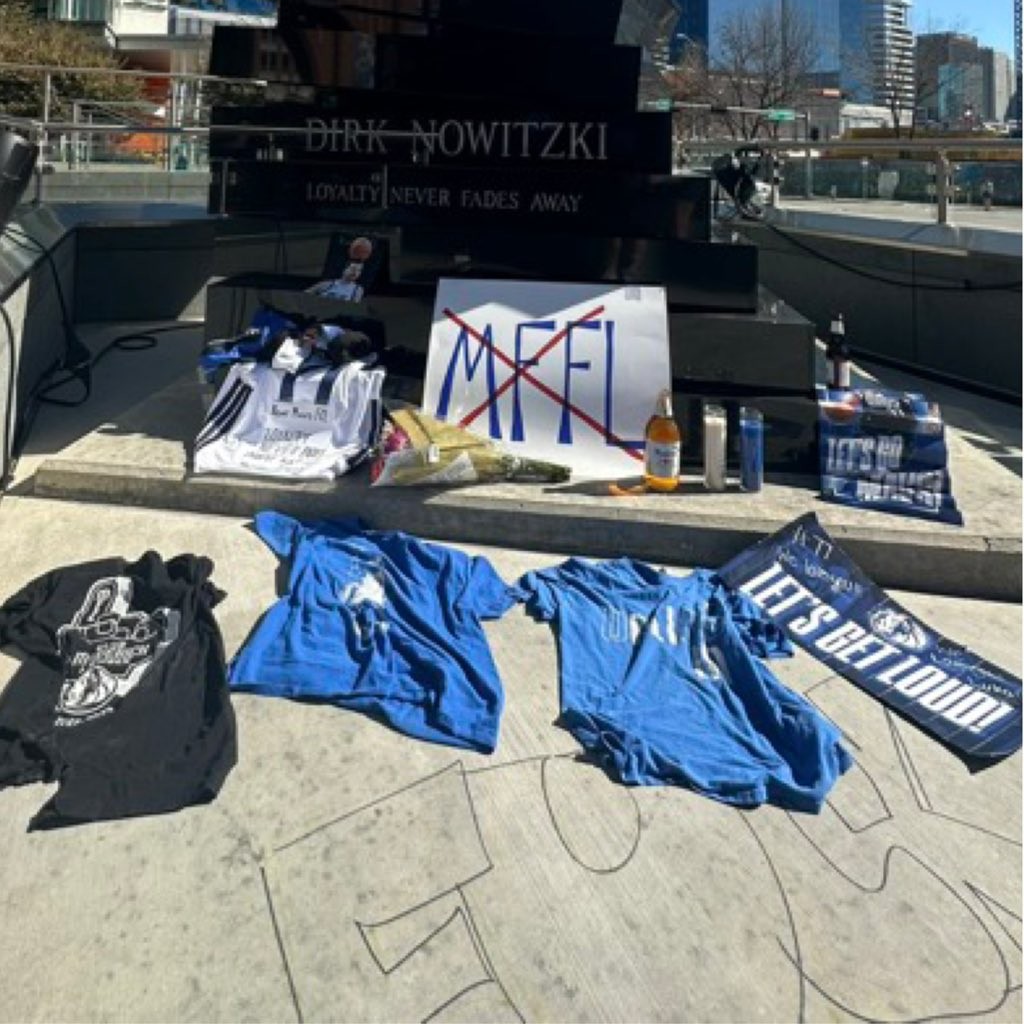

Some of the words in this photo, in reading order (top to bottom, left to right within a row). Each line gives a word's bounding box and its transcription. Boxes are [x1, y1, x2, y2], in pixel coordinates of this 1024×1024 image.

[305, 118, 388, 155] DIRK
[411, 119, 608, 160] NOWITZKI
[306, 181, 381, 202] LOYALTY
[389, 187, 450, 207] NEVER
[461, 189, 520, 210] FADES
[530, 192, 583, 213] AWAY
[436, 319, 646, 450] MFFL
[739, 561, 838, 639] LET'S
[814, 618, 903, 675] GET
[875, 655, 1014, 735] LOUD!
